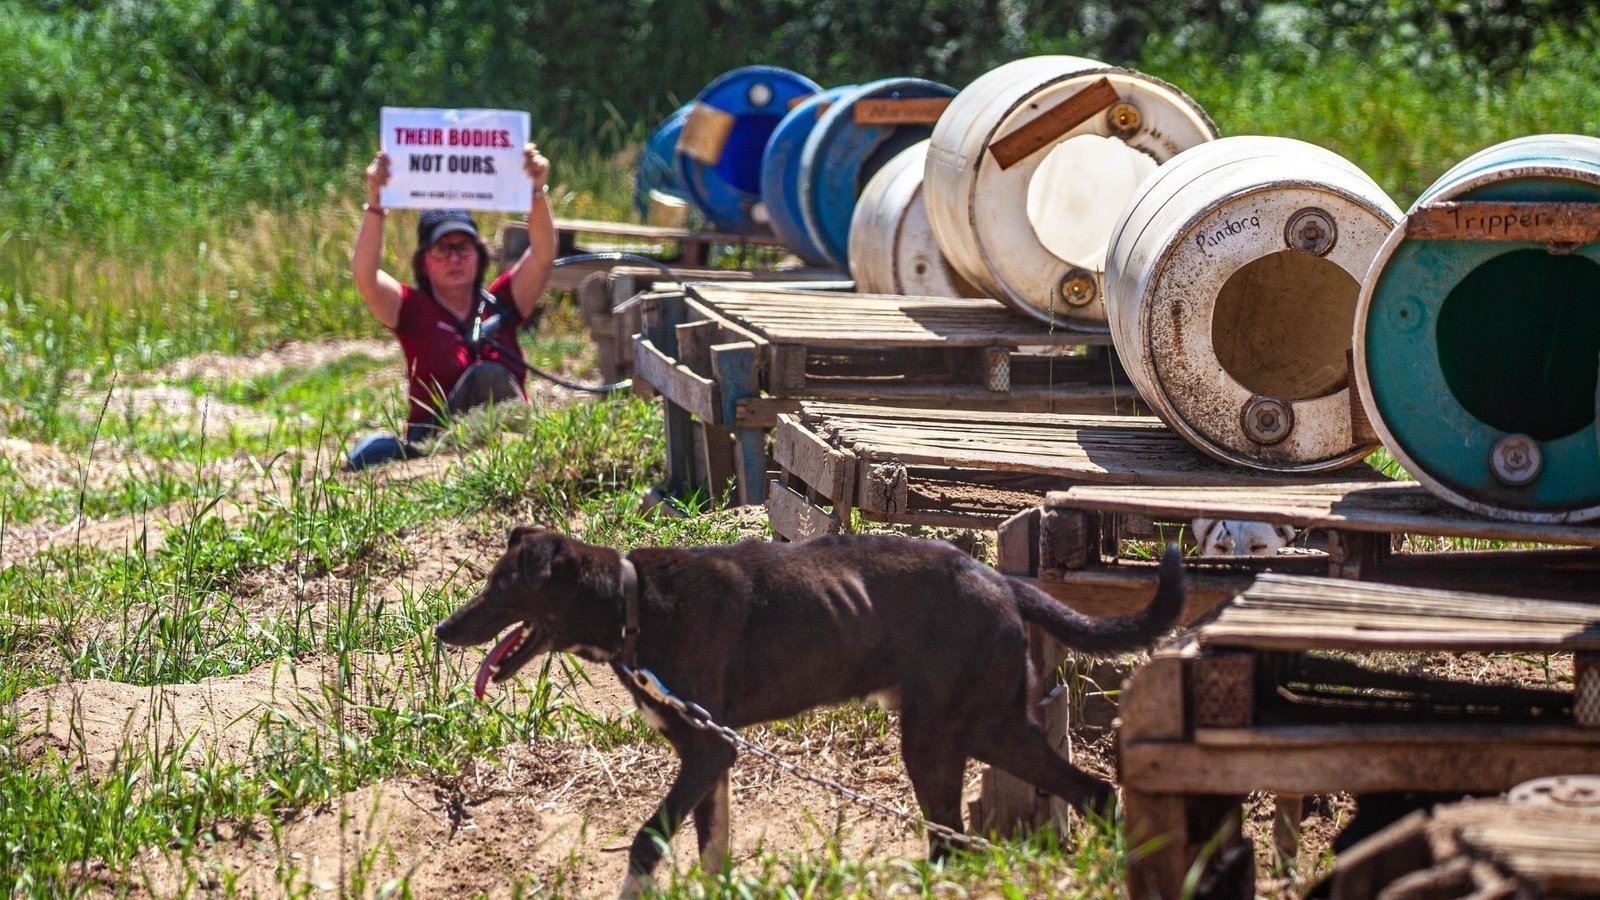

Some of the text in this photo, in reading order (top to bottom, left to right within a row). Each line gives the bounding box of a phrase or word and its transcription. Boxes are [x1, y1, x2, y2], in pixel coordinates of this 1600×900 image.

[394, 127, 514, 149] THEIR BODIES.
[409, 154, 497, 174] NOT OURS.
[1446, 207, 1544, 234] Tripper
